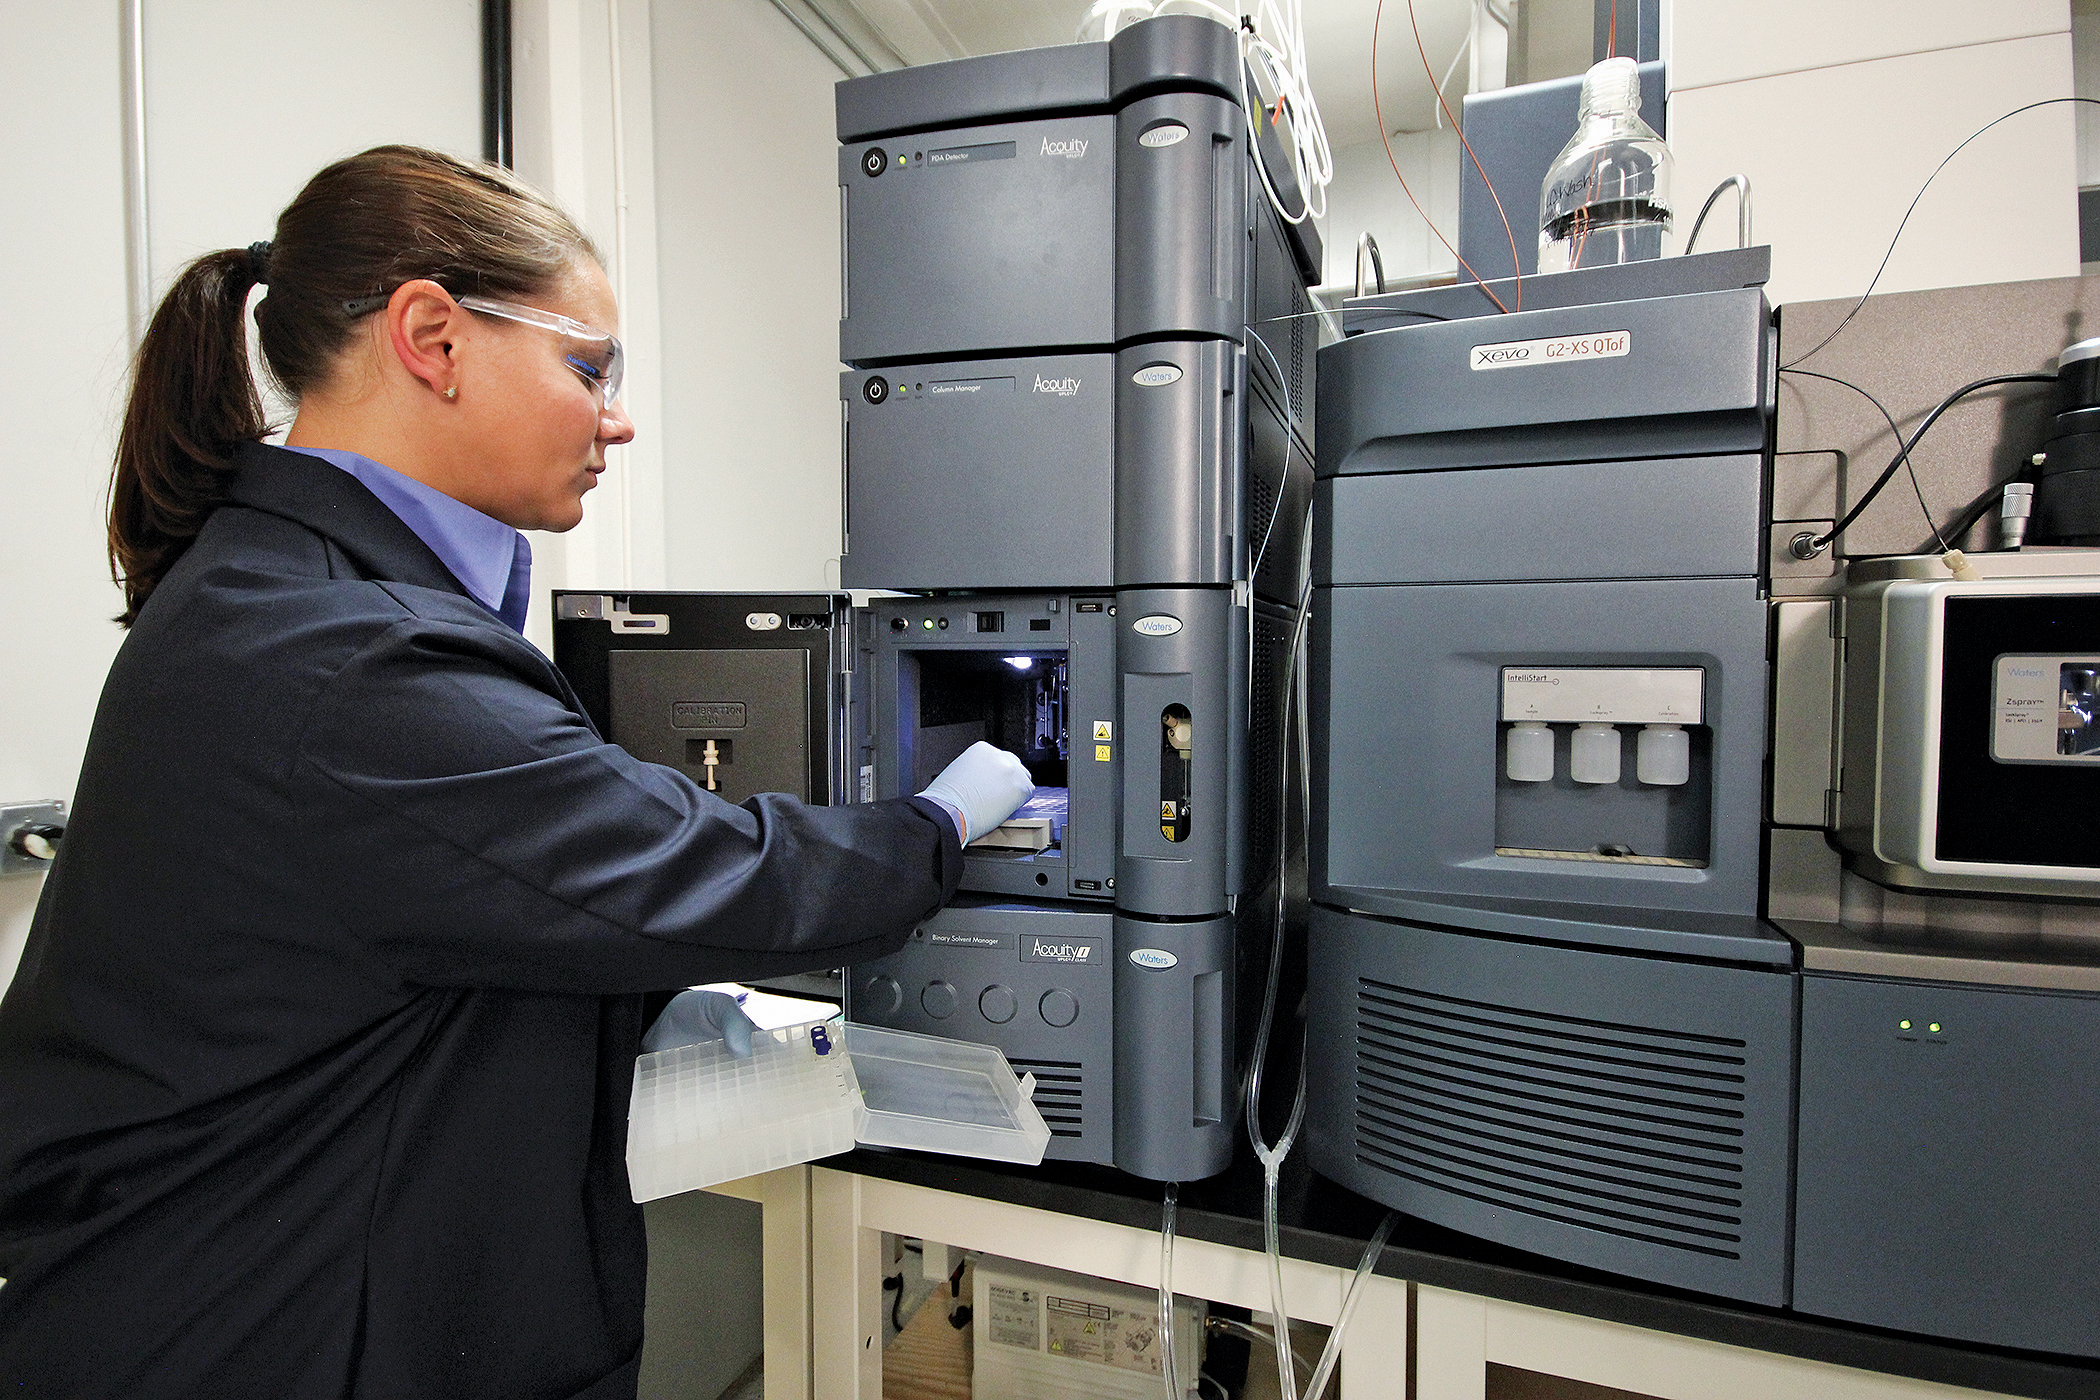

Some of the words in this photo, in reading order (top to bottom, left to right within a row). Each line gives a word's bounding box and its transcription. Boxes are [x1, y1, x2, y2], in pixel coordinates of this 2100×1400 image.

[1148, 132, 1180, 143] Waters
[1040, 136, 1088, 157] Acquity
[931, 154, 945, 162] PDA
[945, 153, 969, 161] Detector
[1477, 347, 1530, 365] Xevo
[1546, 341, 1589, 358] G2-XS
[1593, 337, 1625, 355] QTof
[1141, 370, 1172, 382] Waters
[932, 385, 954, 394] Column
[955, 384, 981, 393] Manager
[1032, 373, 1082, 396] Acquity
[1141, 620, 1173, 632] Waters
[2006, 667, 2045, 677] Waters
[677, 706, 742, 715] CALIBRATION
[932, 934, 951, 943] Binary
[951, 934, 971, 943] Solvent
[972, 936, 999, 946] Manager
[1032, 938, 1079, 961] Acquity
[1138, 952, 1169, 965] Waters
